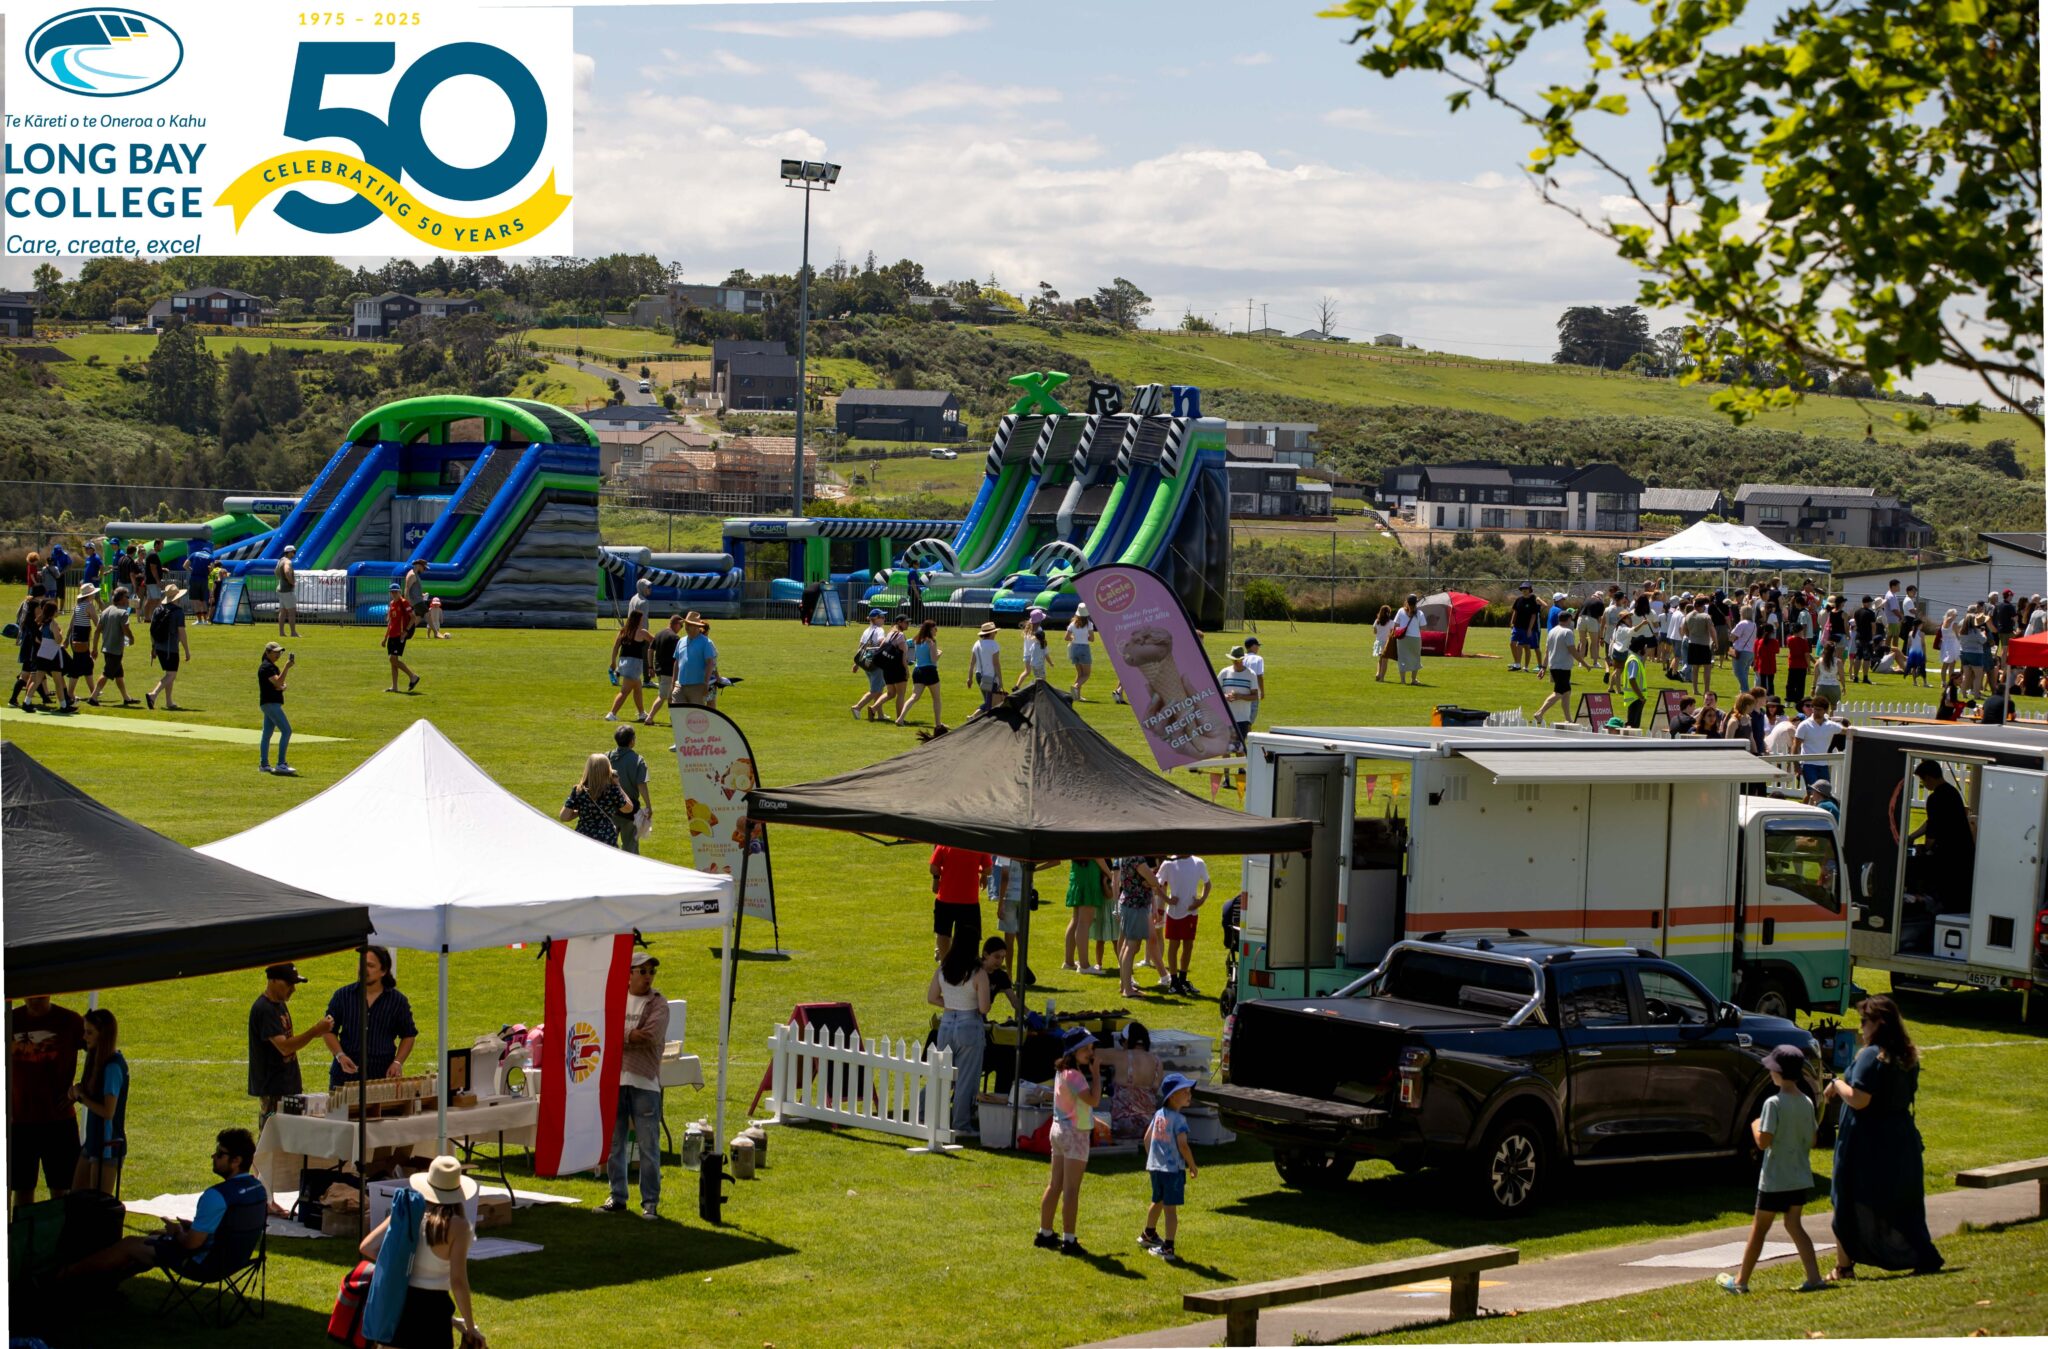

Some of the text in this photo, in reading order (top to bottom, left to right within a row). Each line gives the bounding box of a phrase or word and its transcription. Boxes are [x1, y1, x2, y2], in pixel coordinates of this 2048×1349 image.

[1143, 688, 1216, 729] TRADITIONAL
[1590, 707, 1612, 715] ALCOHOL
[1164, 709, 1203, 735] RECIPE
[1170, 722, 1213, 749] GELATO
[680, 744, 728, 757] Waffles
